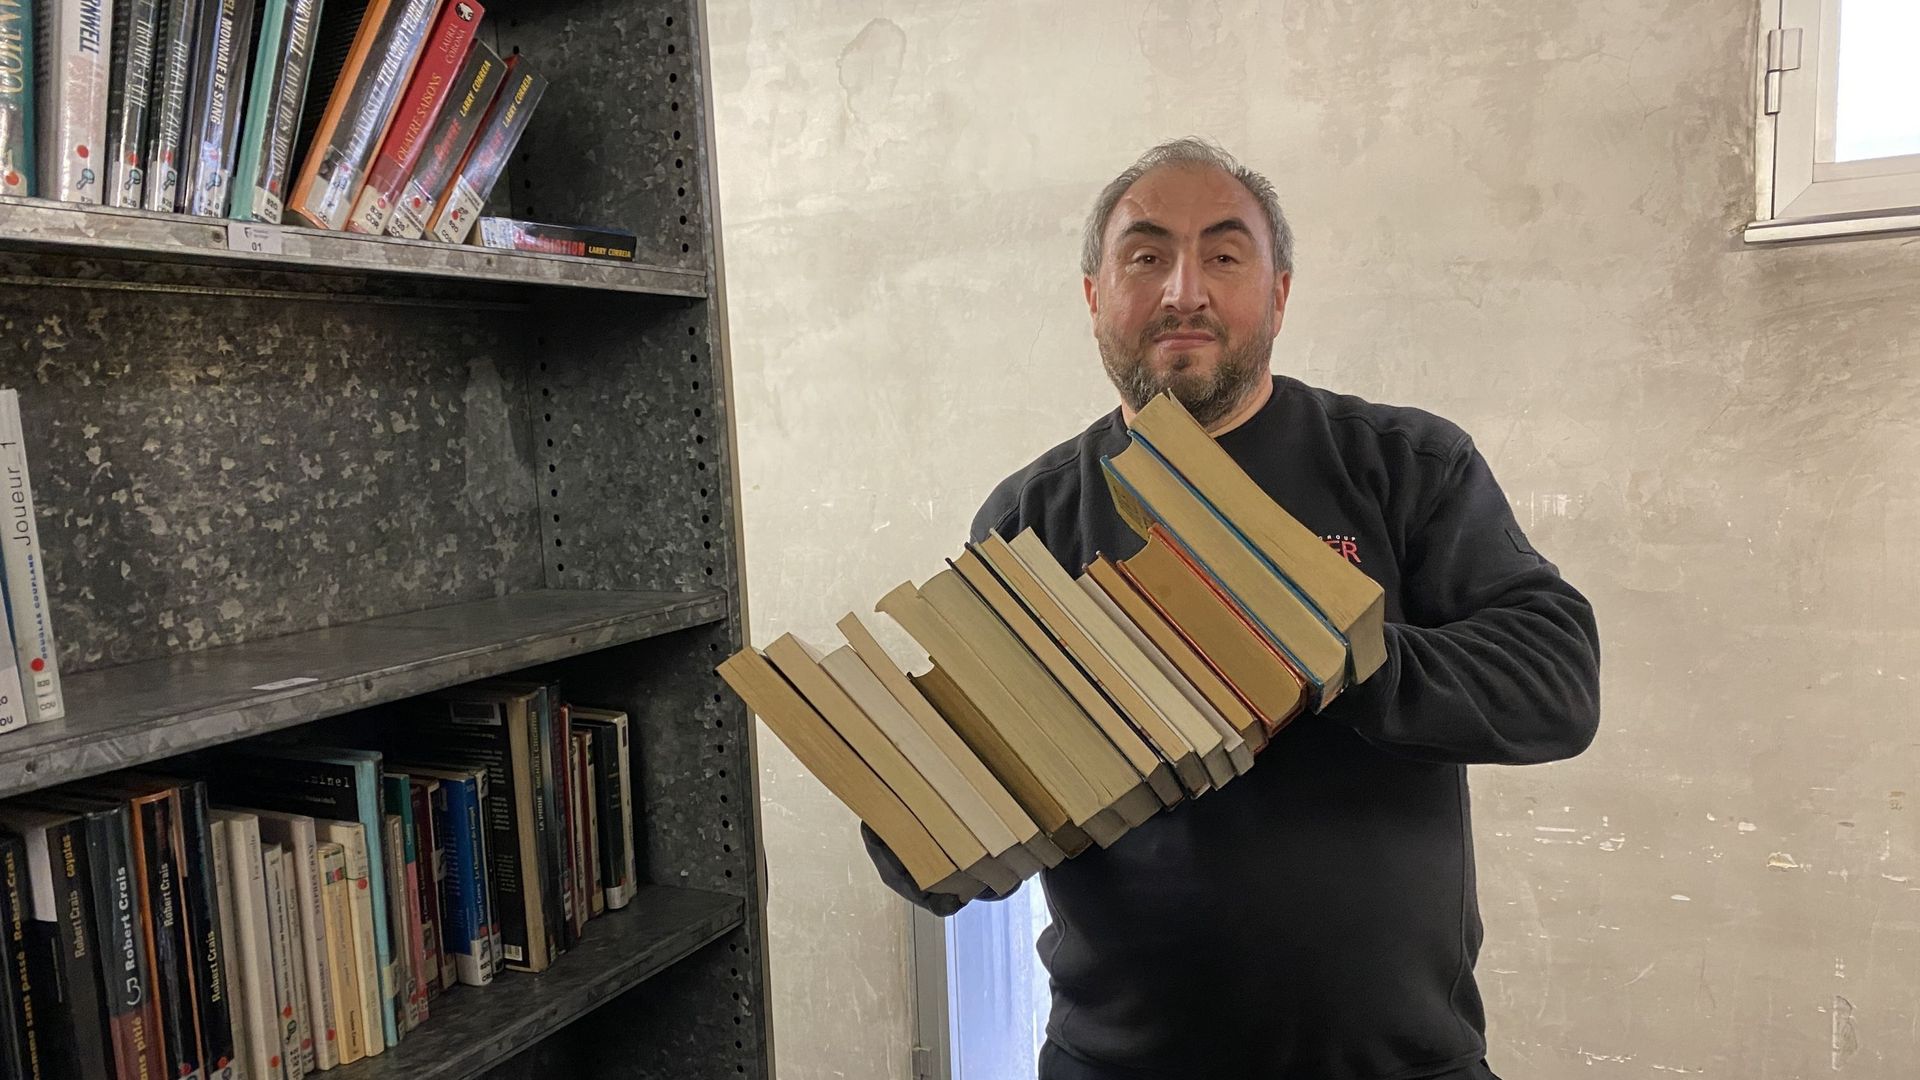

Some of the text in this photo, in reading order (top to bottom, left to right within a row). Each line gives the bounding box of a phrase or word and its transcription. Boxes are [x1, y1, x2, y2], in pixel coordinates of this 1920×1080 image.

[215, 17, 234, 73] MONNAIE
[447, 29, 467, 65] CORONA
[210, 90, 225, 125] SANG
[214, 73, 226, 90] DE
[459, 92, 476, 118] LARRY
[472, 59, 493, 93] CORREIA
[502, 73, 535, 128] LARRY CORREIA
[397, 74, 443, 163] QUATRE SAISONS
[251, 241, 262, 252] 01
[588, 245, 607, 257] LARRY
[607, 246, 632, 259] CORREIA
[27, 553, 40, 609] COUPLAND
[10, 888, 22, 941] Robert
[69, 889, 81, 921] Crais
[116, 866, 136, 971] Robert Crais
[159, 862, 175, 928] Robert Crais
[73, 920, 86, 959] Robert
[207, 930, 222, 1003] Robert Crais
